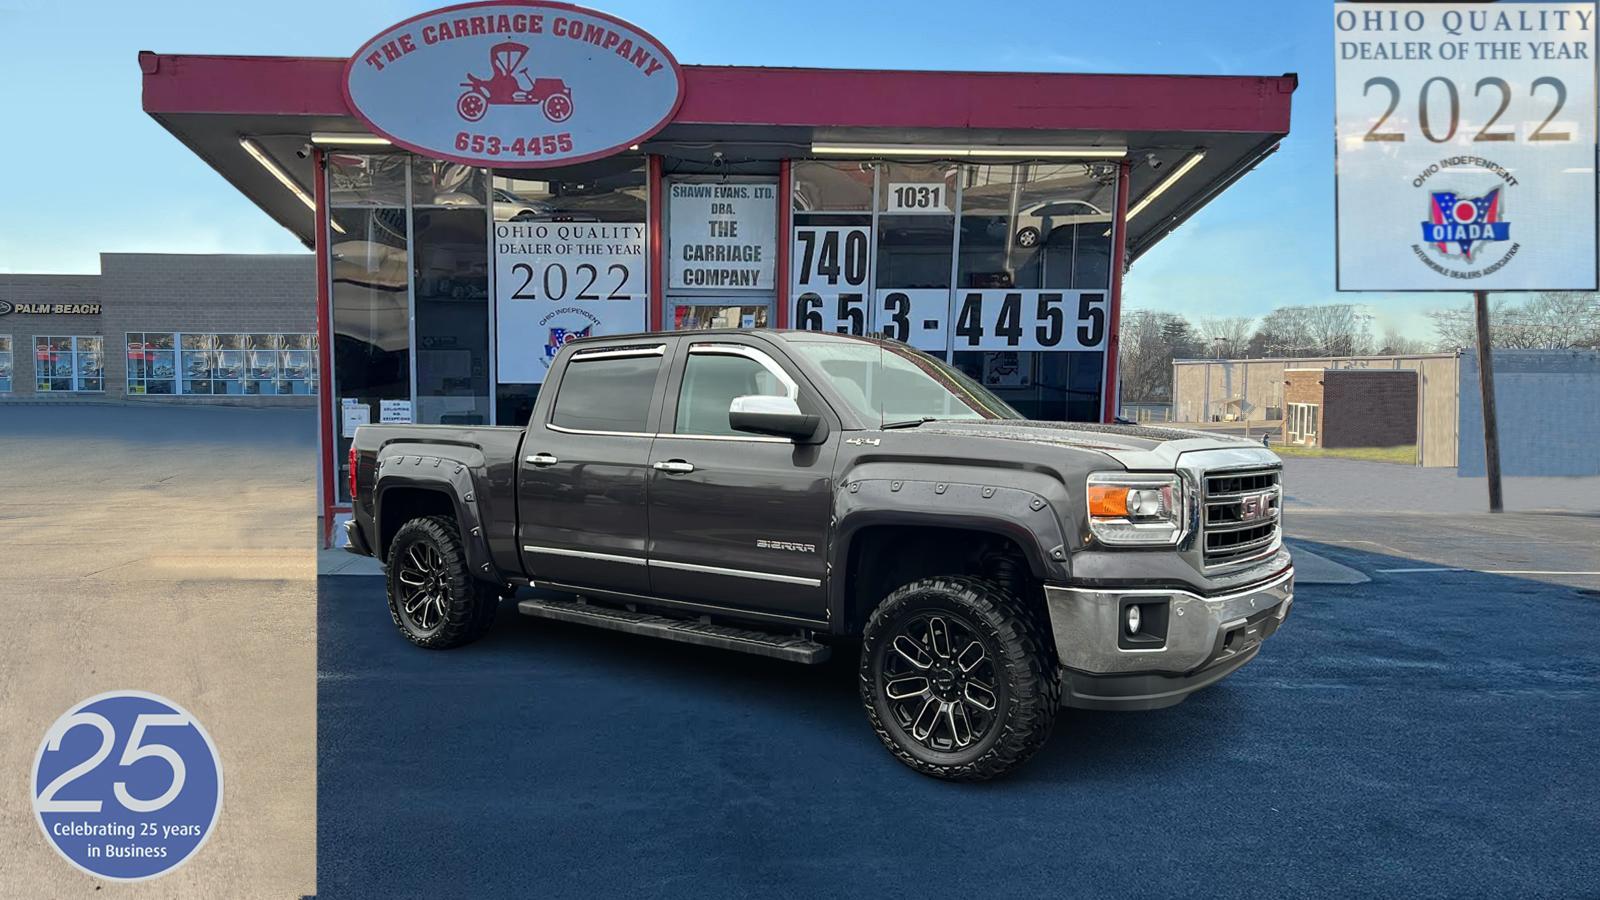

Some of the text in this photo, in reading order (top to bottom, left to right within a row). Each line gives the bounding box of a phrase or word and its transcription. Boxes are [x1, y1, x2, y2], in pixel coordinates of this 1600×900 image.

[1336, 10, 1592, 36] OHIO QUALITY
[366, 14, 664, 77] THE CARRIAGE COMPANY
[1340, 42, 1590, 60] DEALER OF THE YEAR
[1363, 76, 1571, 143] 2022
[455, 132, 573, 157] 653-4455
[1412, 156, 1519, 188] OHIO INDEPENDENT
[673, 186, 711, 198] SHAWN
[754, 187, 774, 199] LTD.
[895, 186, 940, 208] 1031
[711, 203, 736, 215] DBA.
[497, 225, 644, 240] OHIO QUALITY
[709, 220, 738, 238] THE
[1433, 224, 1495, 240] OIADA
[499, 244, 641, 255] DEALER OF THE YEAR
[683, 244, 762, 262] CARRIAGE
[797, 230, 868, 286] 740
[511, 263, 632, 300] 2022
[683, 268, 760, 286] COMPANY
[15, 304, 100, 314] PALM BEACH
[539, 312, 555, 326] OHIO
[757, 539, 816, 553] SIERRA
